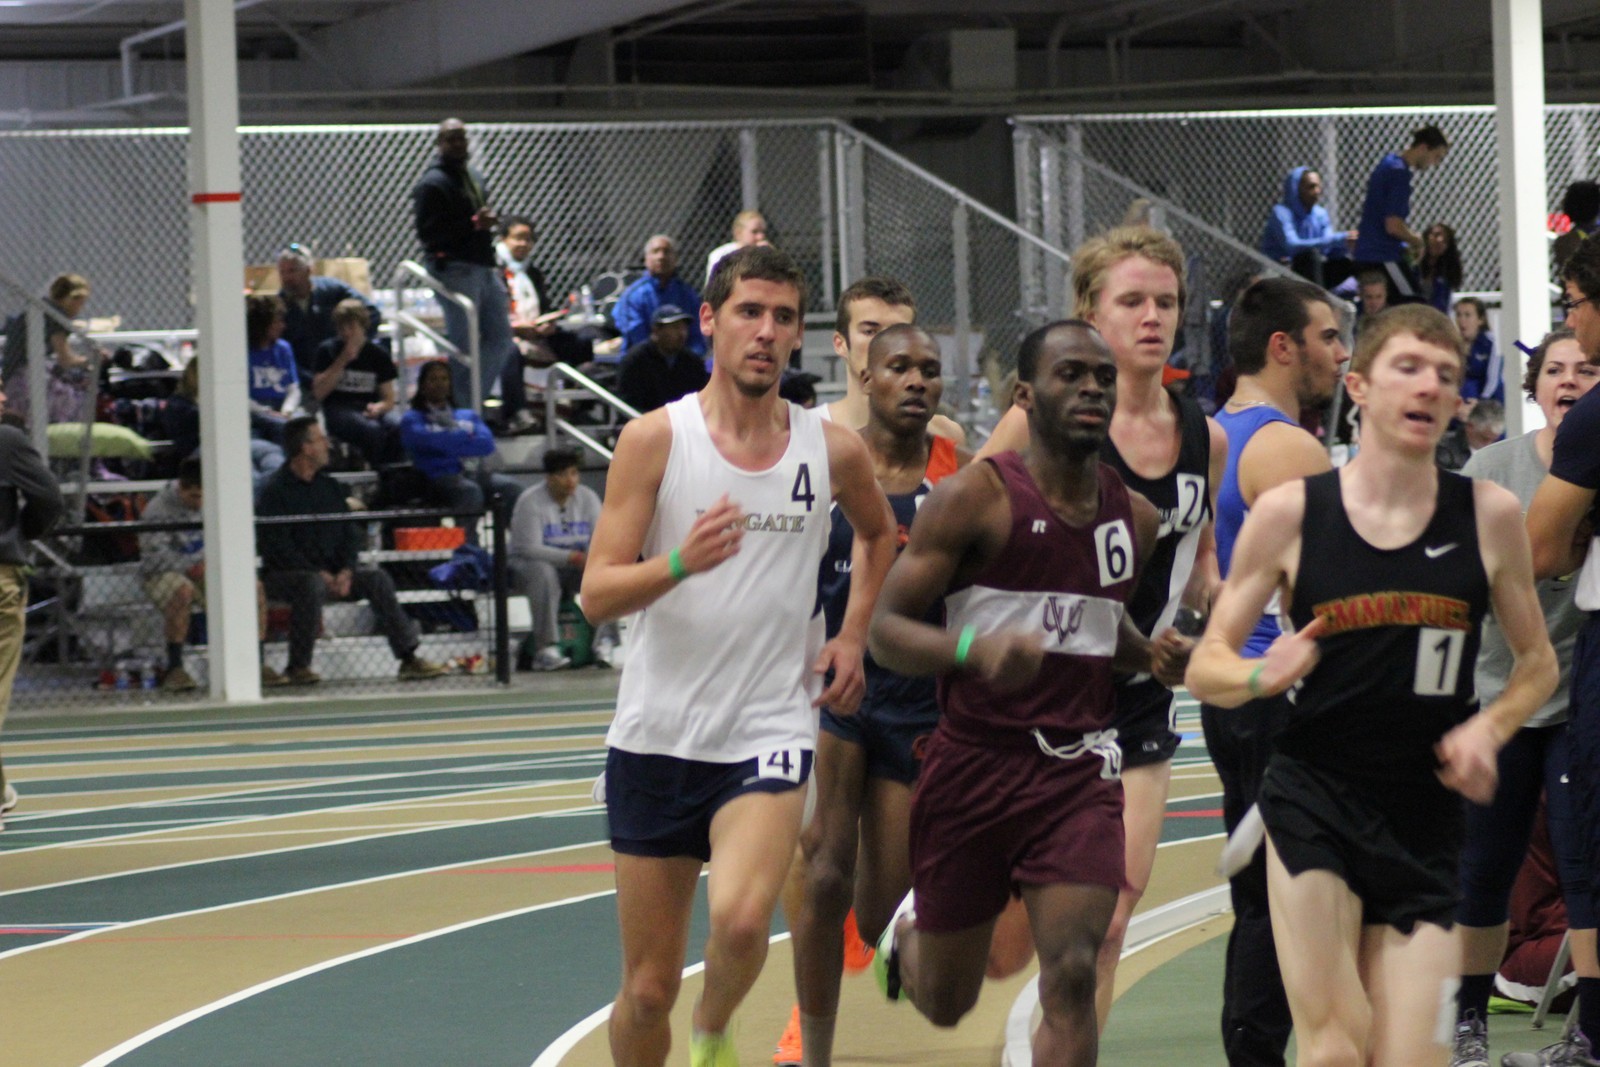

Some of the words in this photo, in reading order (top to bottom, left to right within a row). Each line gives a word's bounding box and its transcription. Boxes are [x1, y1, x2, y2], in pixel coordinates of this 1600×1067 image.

[791, 463, 815, 512] 4
[1181, 480, 1199, 527] 2
[695, 508, 805, 532] GATE
[1105, 526, 1127, 579] 6
[1434, 635, 1452, 690] 1
[766, 749, 794, 775] 4
